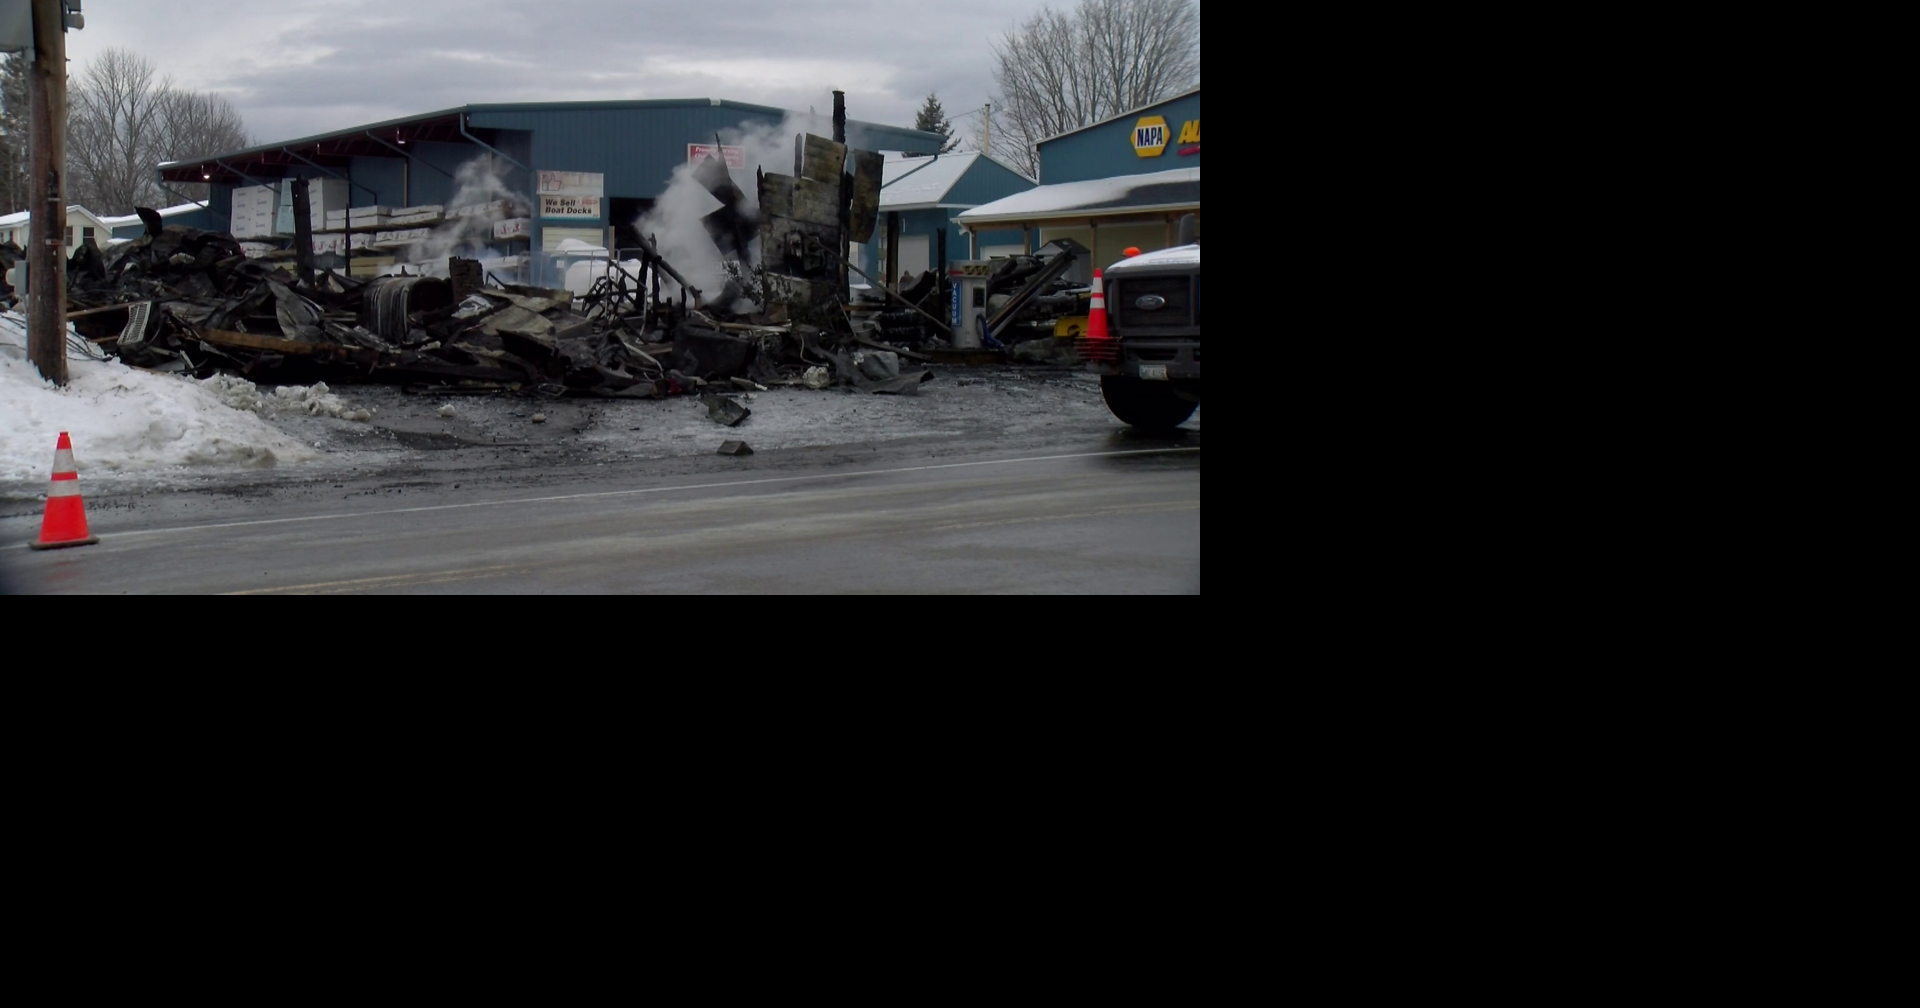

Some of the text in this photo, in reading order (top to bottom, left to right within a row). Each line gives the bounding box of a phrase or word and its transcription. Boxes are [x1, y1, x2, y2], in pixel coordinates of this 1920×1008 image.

[1137, 127, 1163, 147] NAPA
[545, 198, 557, 206] We
[545, 206, 564, 214] Boat
